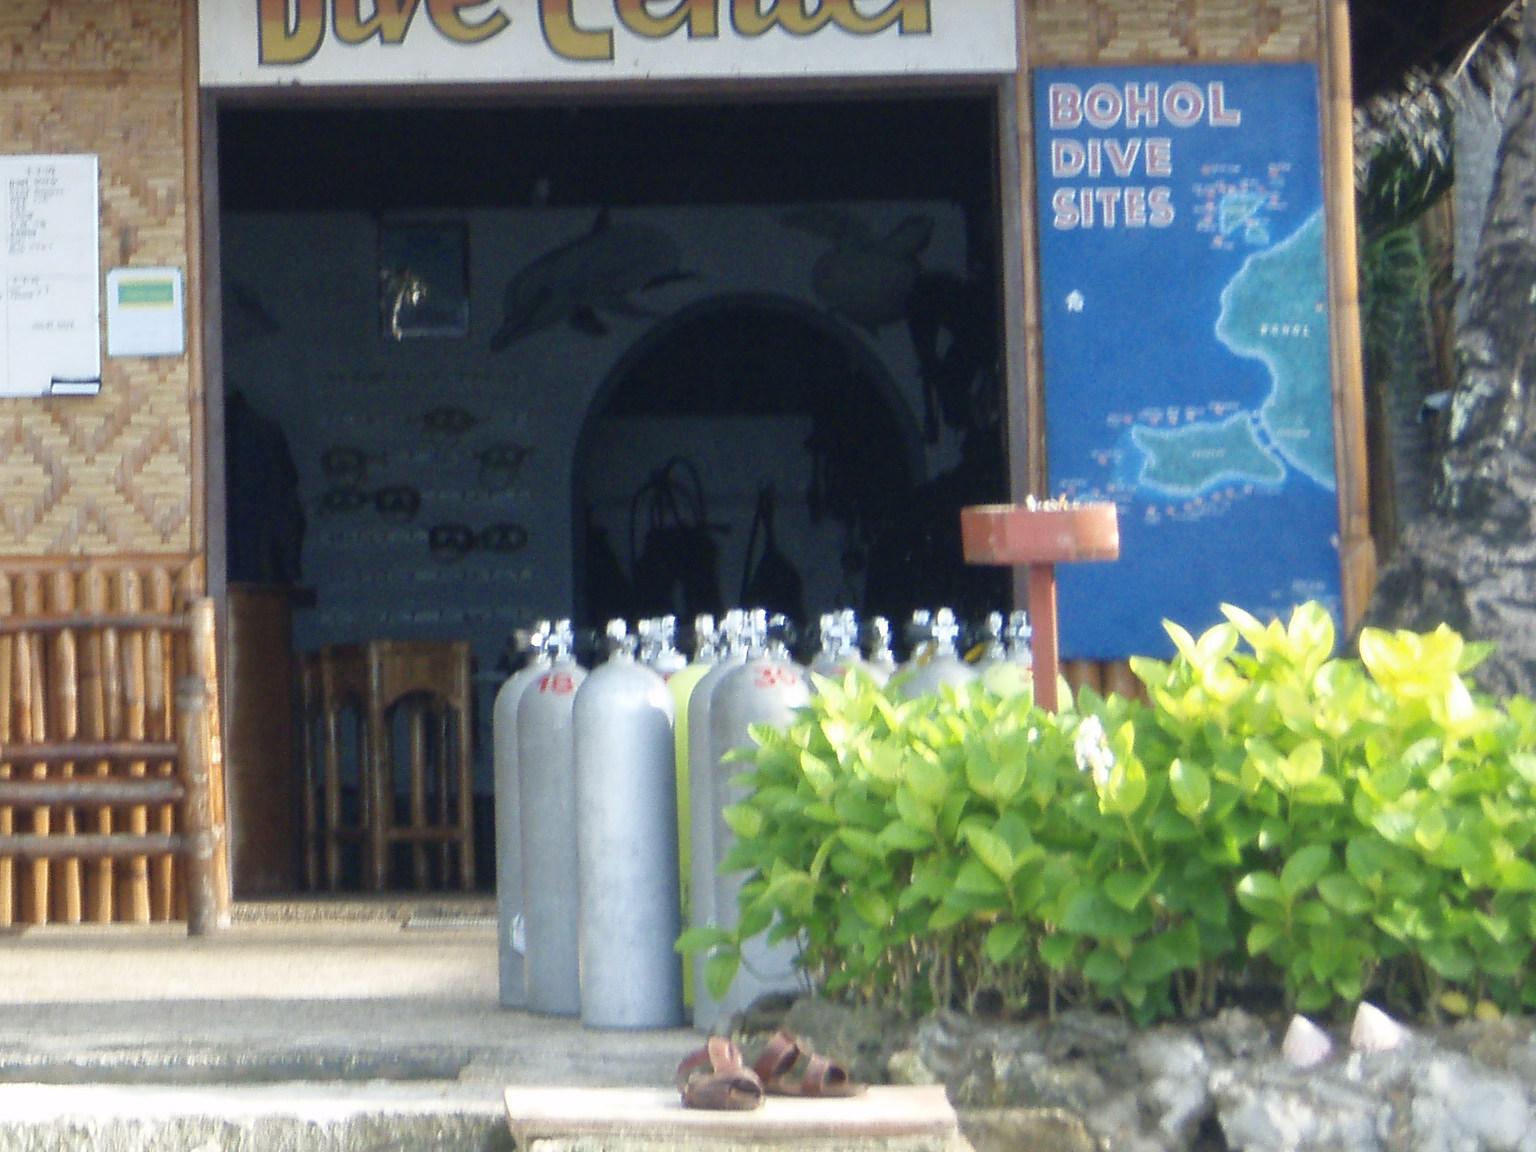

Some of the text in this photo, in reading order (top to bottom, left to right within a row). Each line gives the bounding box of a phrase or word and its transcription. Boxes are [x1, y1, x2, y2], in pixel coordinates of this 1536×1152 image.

[1049, 80, 1242, 130] BOHOL
[1051, 137, 1172, 178] DIVE
[1052, 186, 1175, 230] SITES
